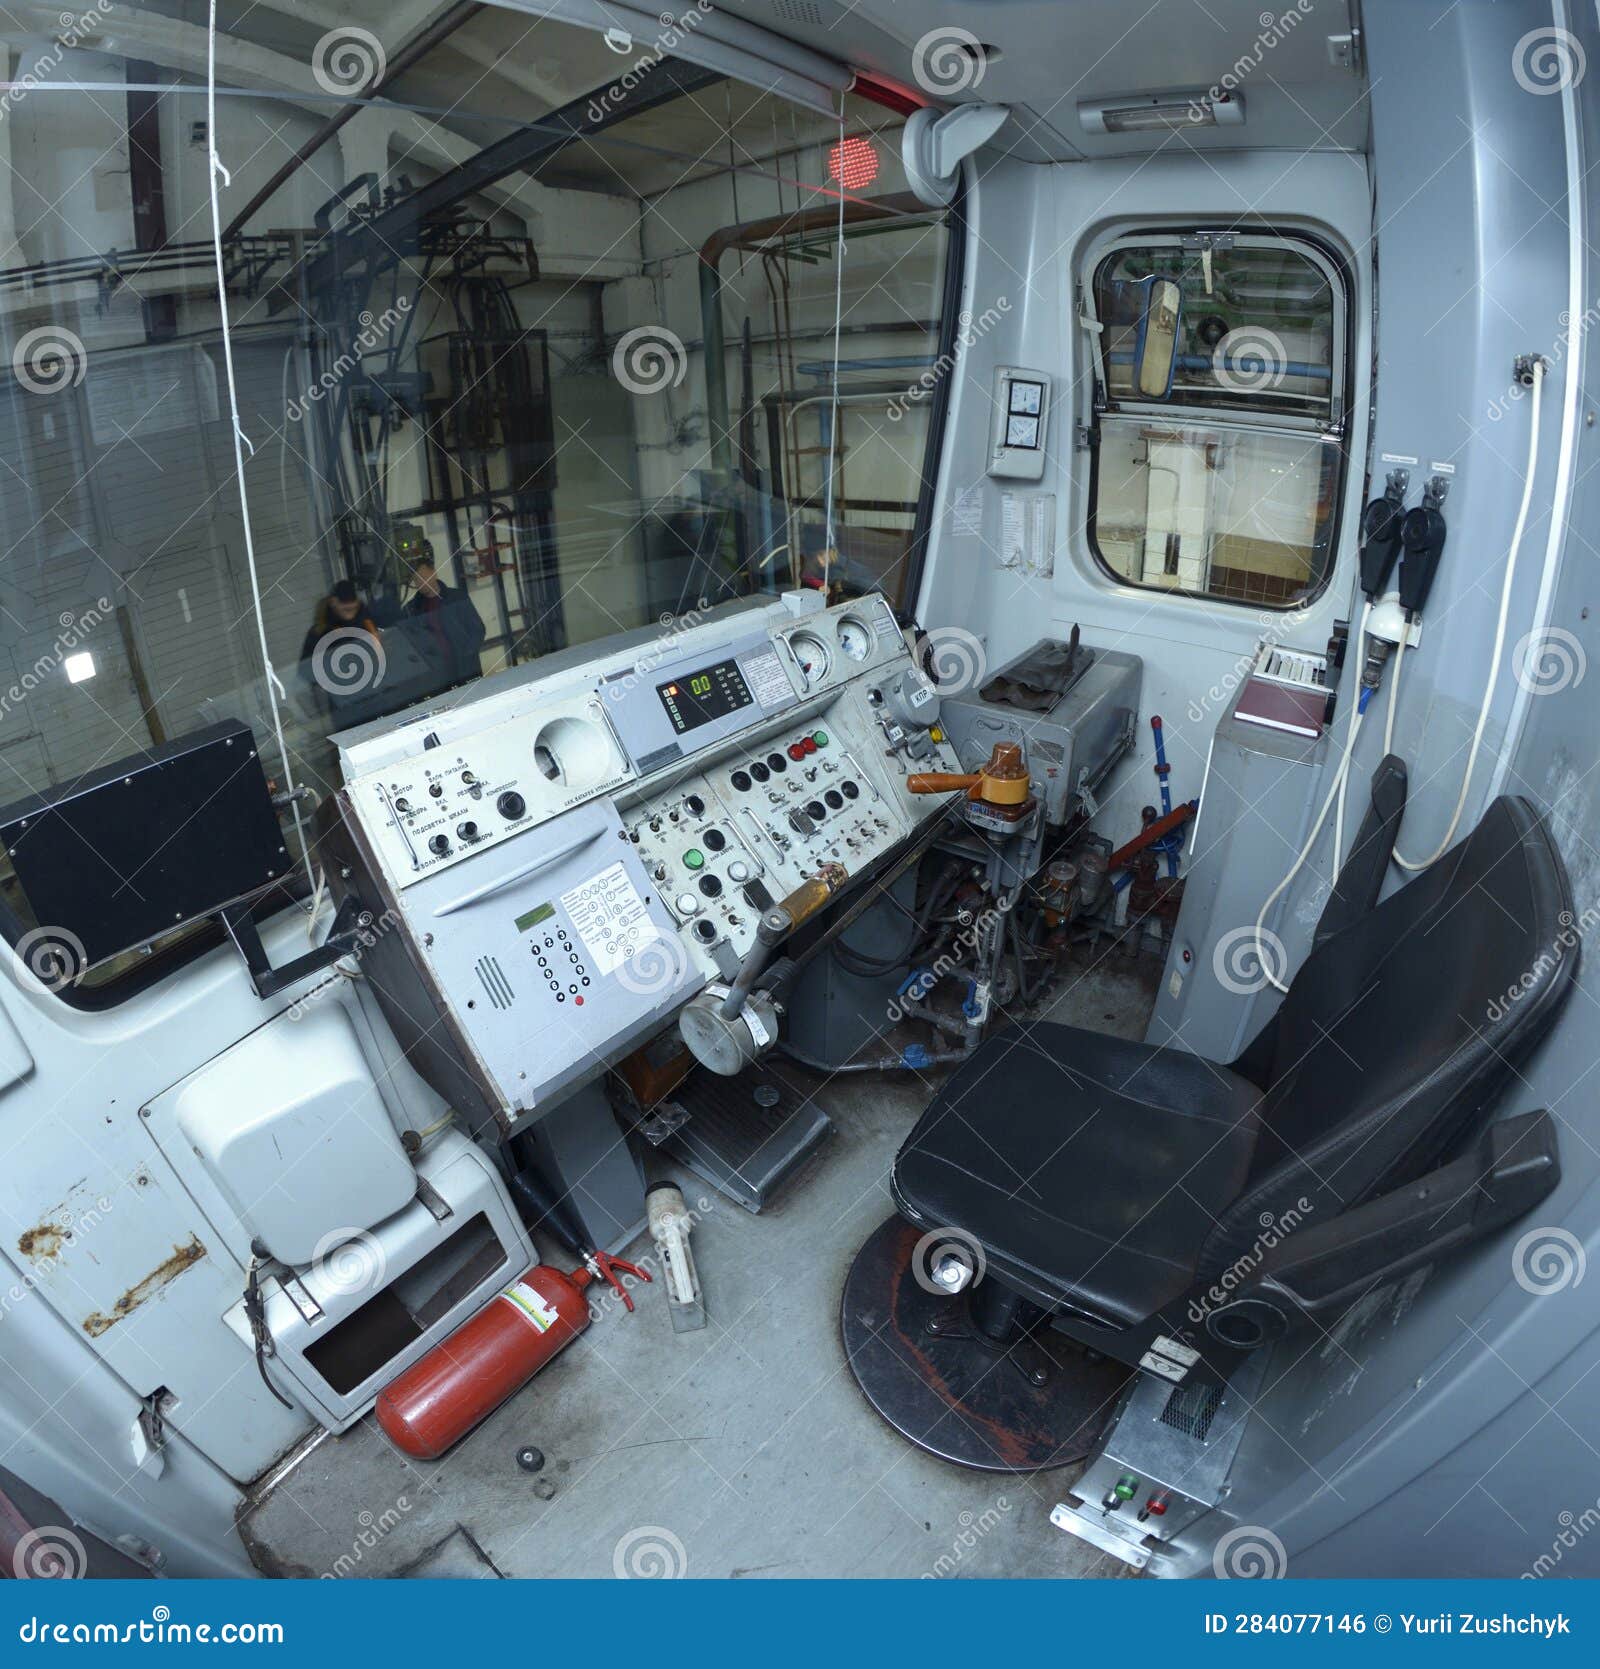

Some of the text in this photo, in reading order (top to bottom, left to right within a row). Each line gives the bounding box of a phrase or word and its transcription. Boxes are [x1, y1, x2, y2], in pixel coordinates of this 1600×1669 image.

[386, 806, 427, 827] КОПРЕССОРА
[412, 818, 446, 836] ПОДСВЕТКА
[420, 849, 455, 869] ВОЛЬТТР
